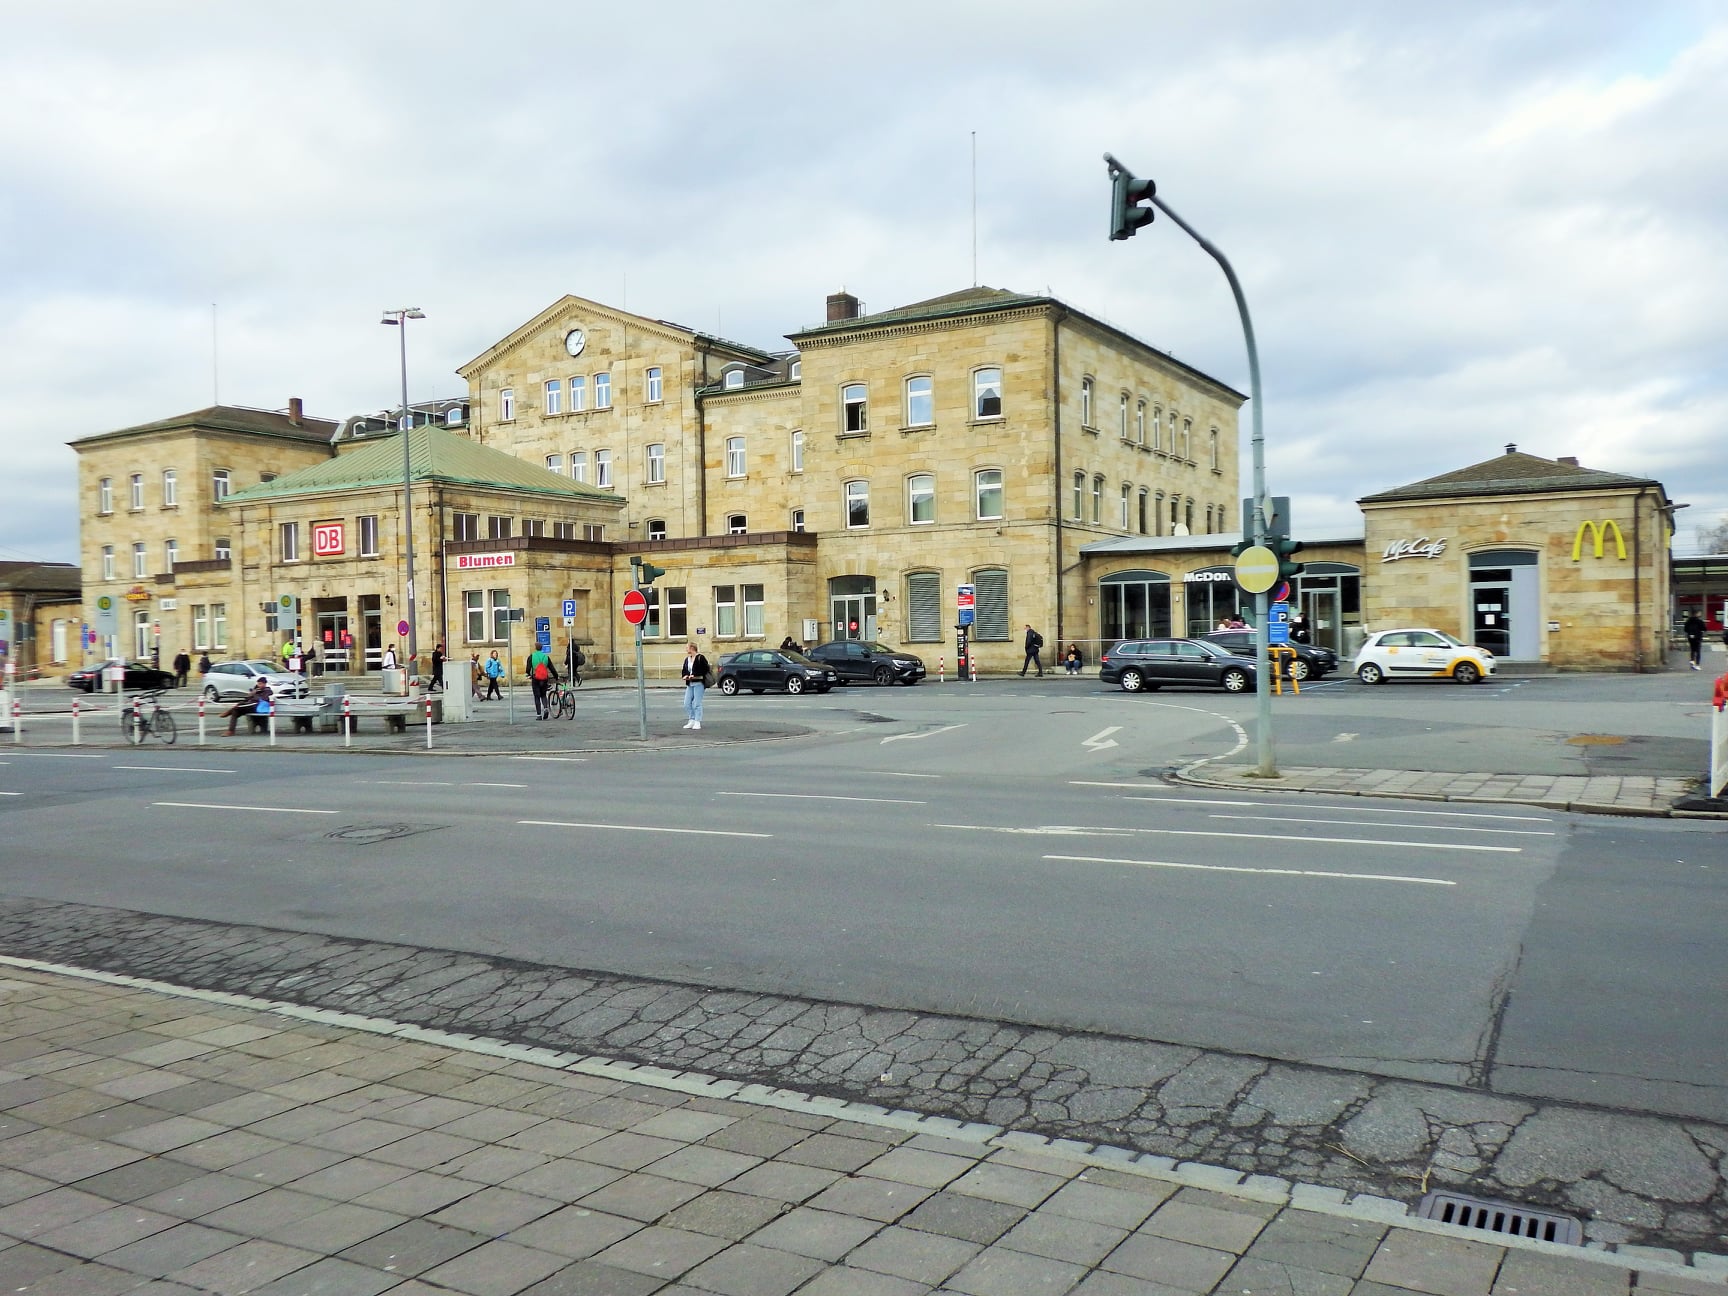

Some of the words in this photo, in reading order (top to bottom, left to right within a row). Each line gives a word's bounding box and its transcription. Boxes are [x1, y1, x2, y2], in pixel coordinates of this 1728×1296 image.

[317, 529, 340, 550] DB
[459, 555, 513, 568] Blumen
[565, 602, 573, 615] P
[1278, 612, 1287, 622] P
